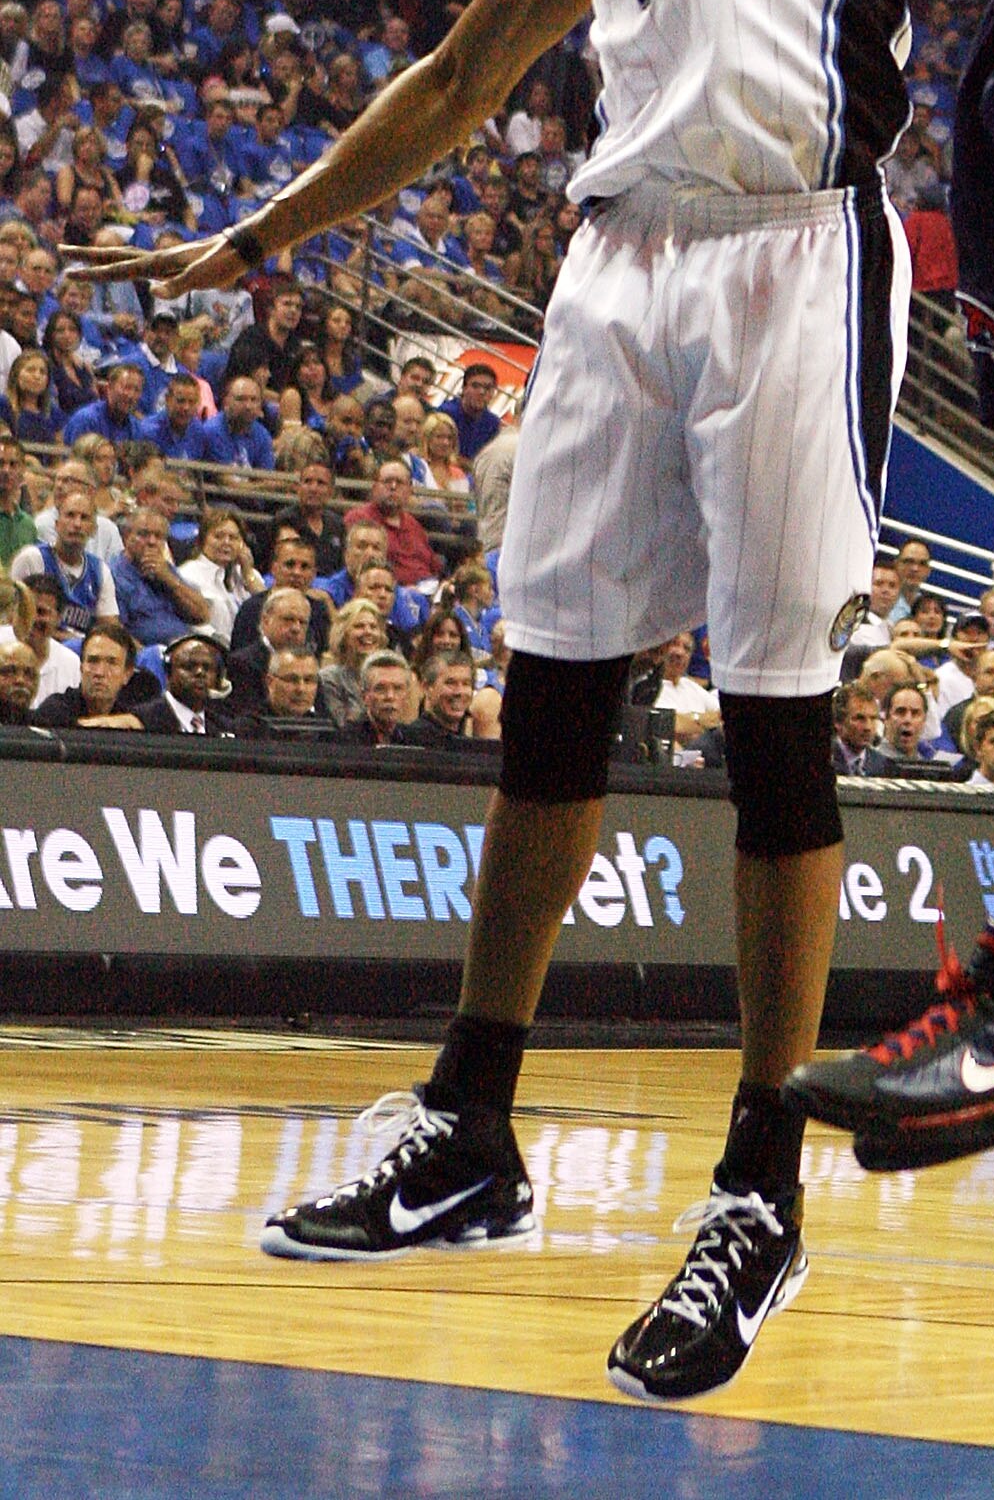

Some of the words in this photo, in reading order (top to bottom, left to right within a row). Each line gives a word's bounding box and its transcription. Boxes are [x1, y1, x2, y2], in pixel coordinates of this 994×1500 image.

[0, 827, 104, 912] re
[101, 806, 262, 920] We
[562, 831, 686, 927] et?
[896, 845, 945, 923] 2
